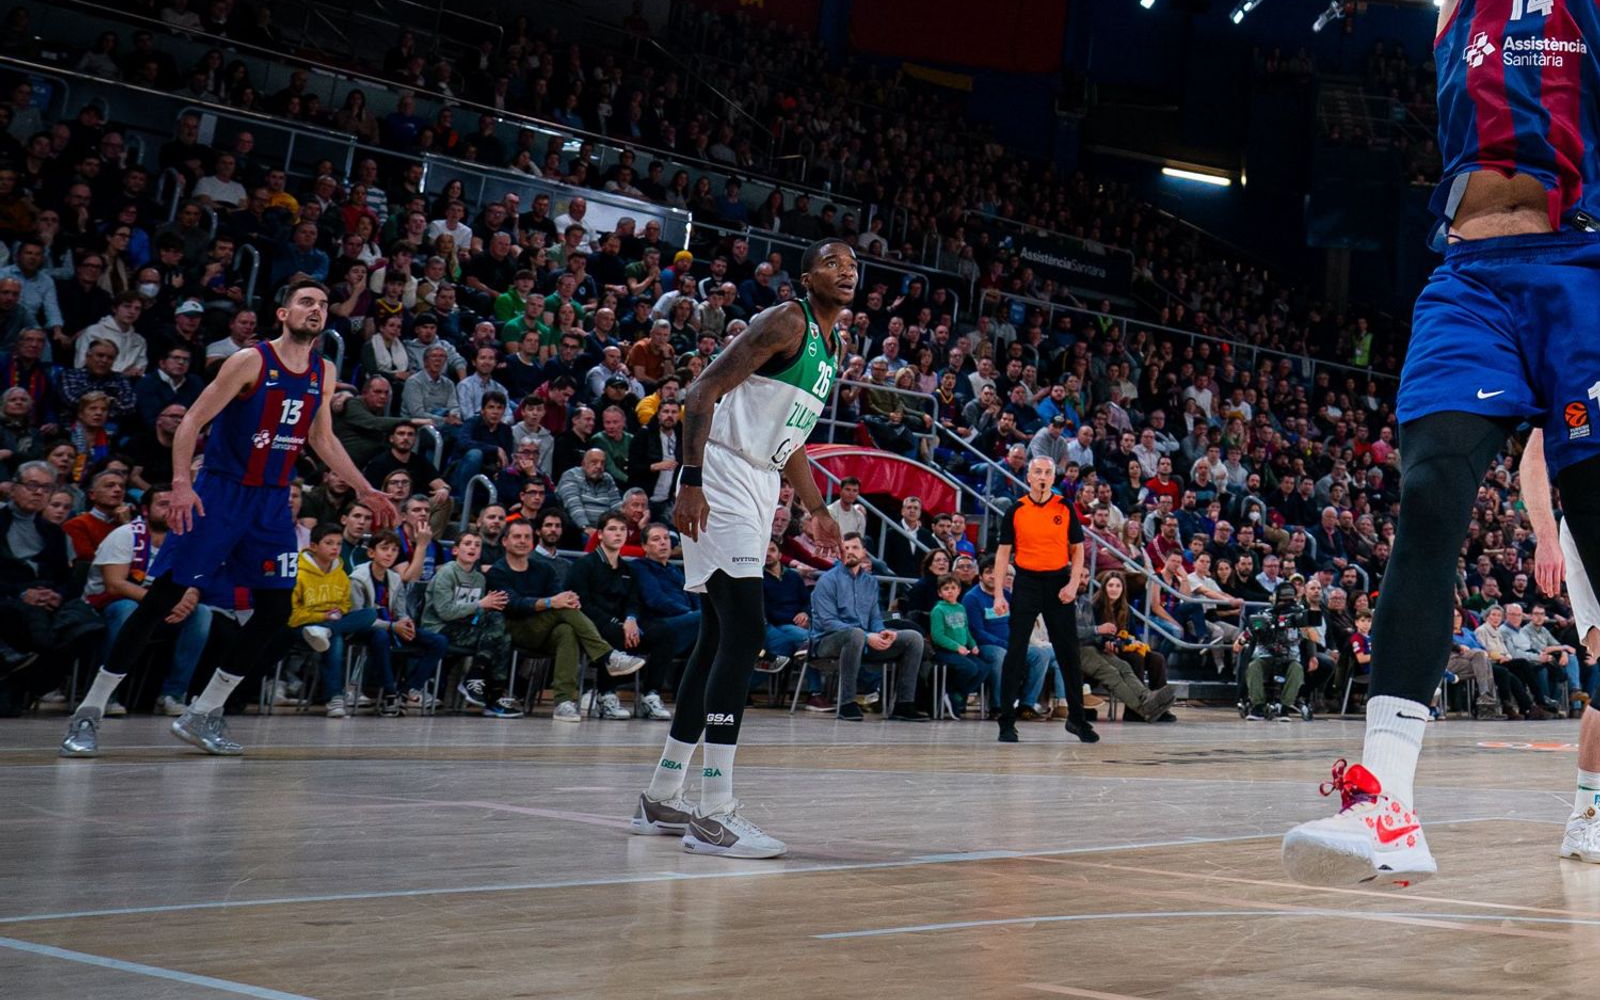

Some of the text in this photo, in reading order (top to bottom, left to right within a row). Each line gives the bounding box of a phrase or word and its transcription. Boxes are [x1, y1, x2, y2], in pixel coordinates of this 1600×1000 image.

[1503, 35, 1587, 54] Assistència
[1503, 51, 1563, 67] Sanitària
[812, 360, 832, 398] 26
[280, 399, 304, 425] 13
[277, 552, 298, 577] 13
[707, 713, 734, 723] GSA
[661, 759, 682, 770] GSA
